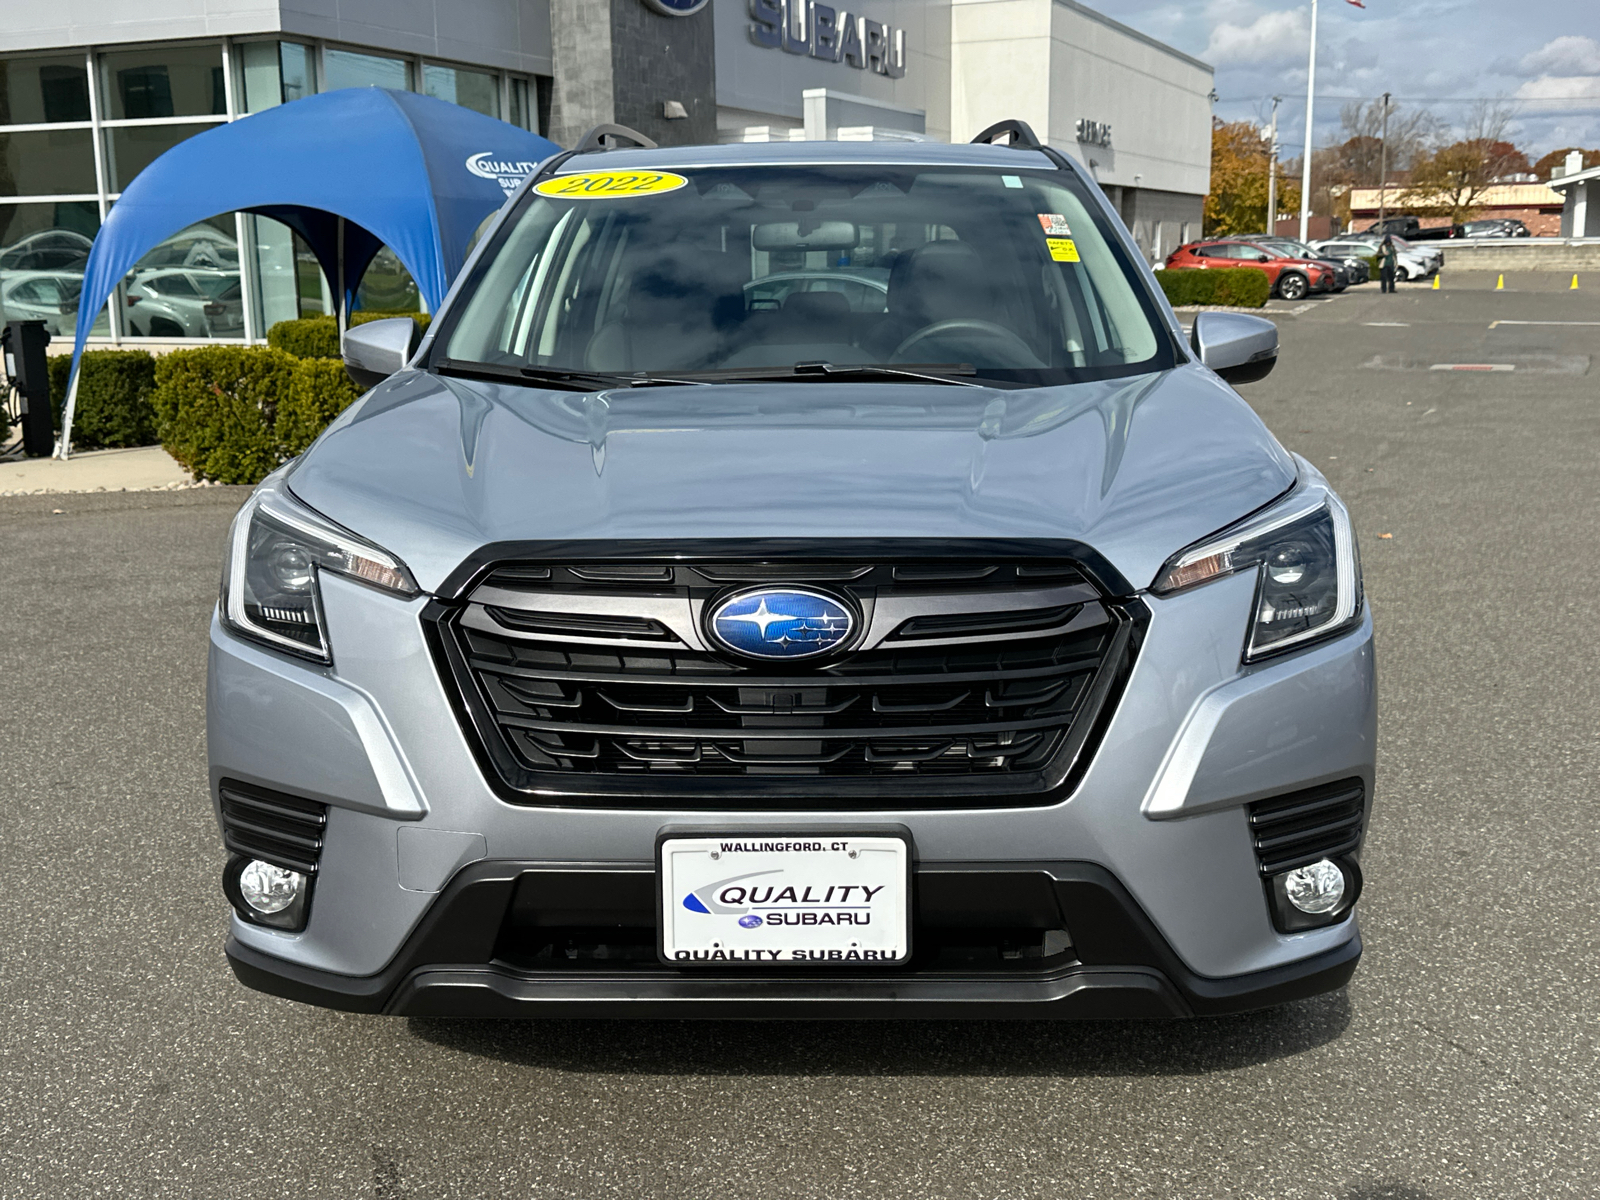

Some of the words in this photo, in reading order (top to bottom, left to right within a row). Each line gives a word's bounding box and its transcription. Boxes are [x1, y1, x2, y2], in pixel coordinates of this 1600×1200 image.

[747, 0, 907, 79] SUBARU
[478, 160, 537, 173] QUALITY
[556, 175, 663, 194] 2022
[831, 842, 848, 851] CT
[719, 886, 885, 905] QUALITY
[766, 913, 871, 925] SUBARU
[674, 949, 781, 961] QUALITY
[792, 949, 897, 961] SUBARU
